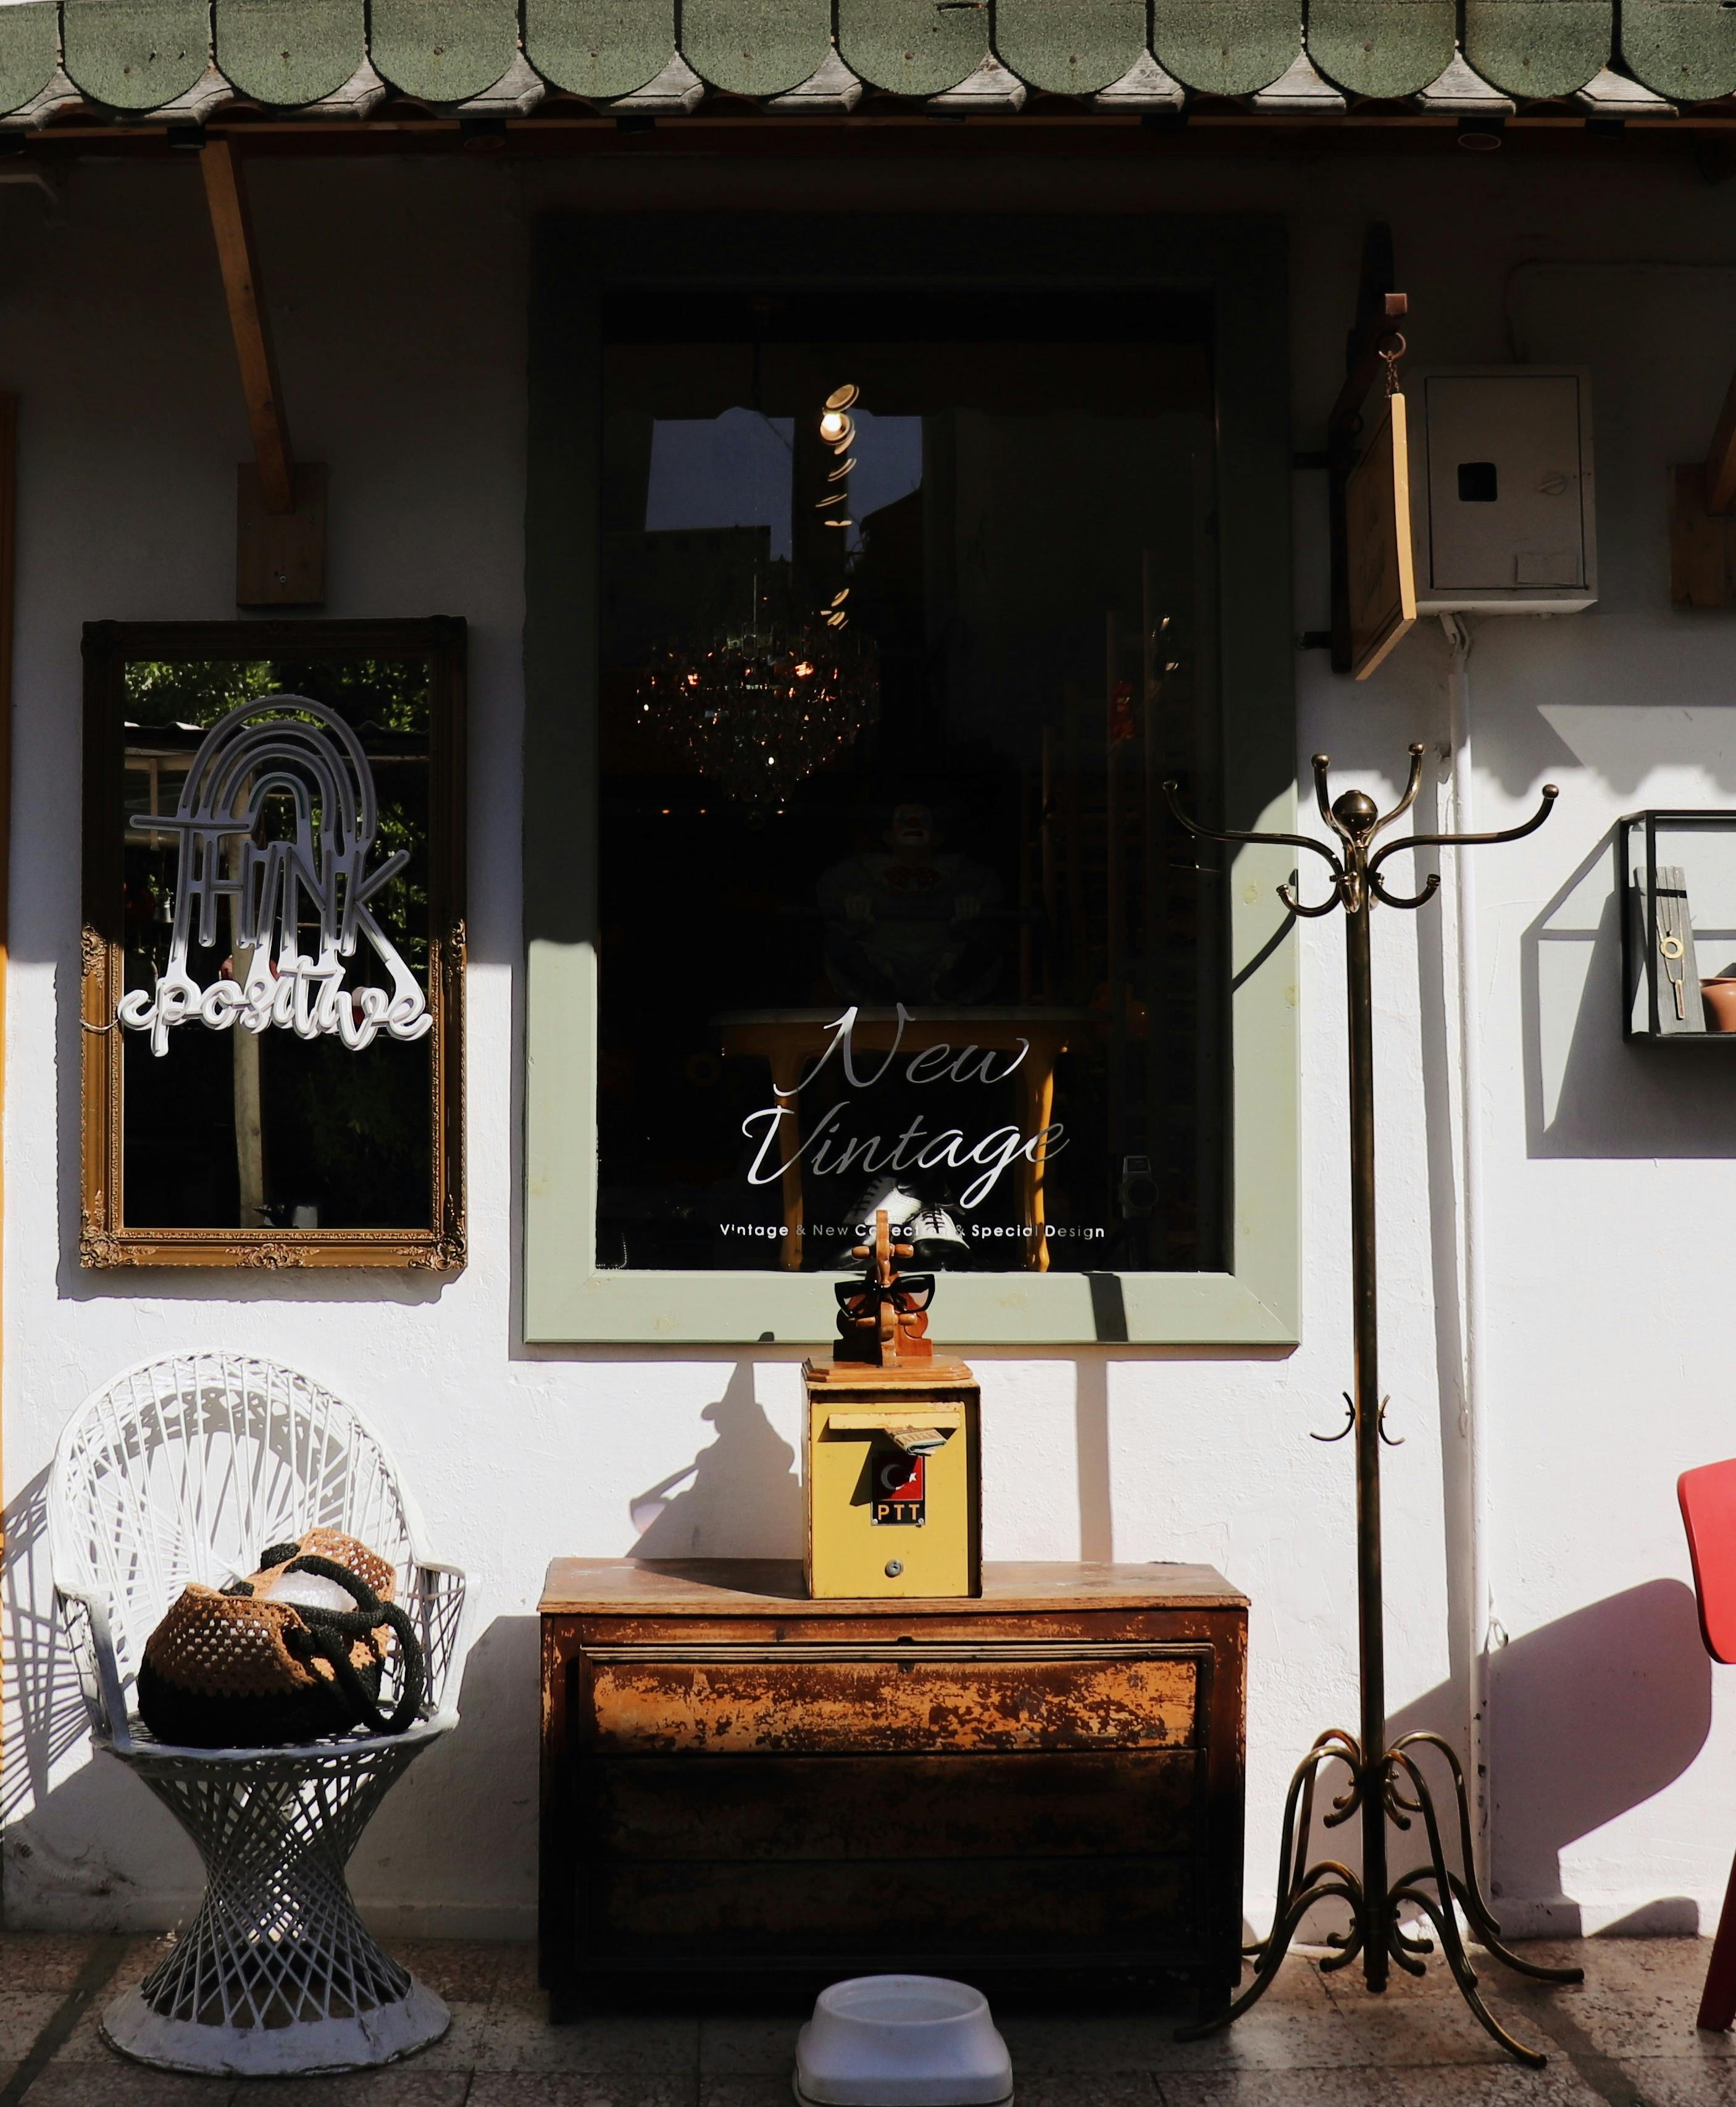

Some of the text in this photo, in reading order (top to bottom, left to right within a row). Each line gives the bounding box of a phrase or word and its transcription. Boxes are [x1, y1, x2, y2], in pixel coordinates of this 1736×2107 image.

[130, 812, 411, 965] THINK
[119, 955, 432, 1057] positive
[773, 1002, 1030, 1097] New
[741, 1101, 1070, 1210] Vintage
[720, 1223, 789, 1239] Vintage
[796, 1224, 806, 1236] &
[812, 1224, 849, 1236] New
[956, 1225, 966, 1236] &
[972, 1224, 1038, 1239] Special
[1045, 1225, 1104, 1240] Design
[877, 1504, 920, 1521] PTT
